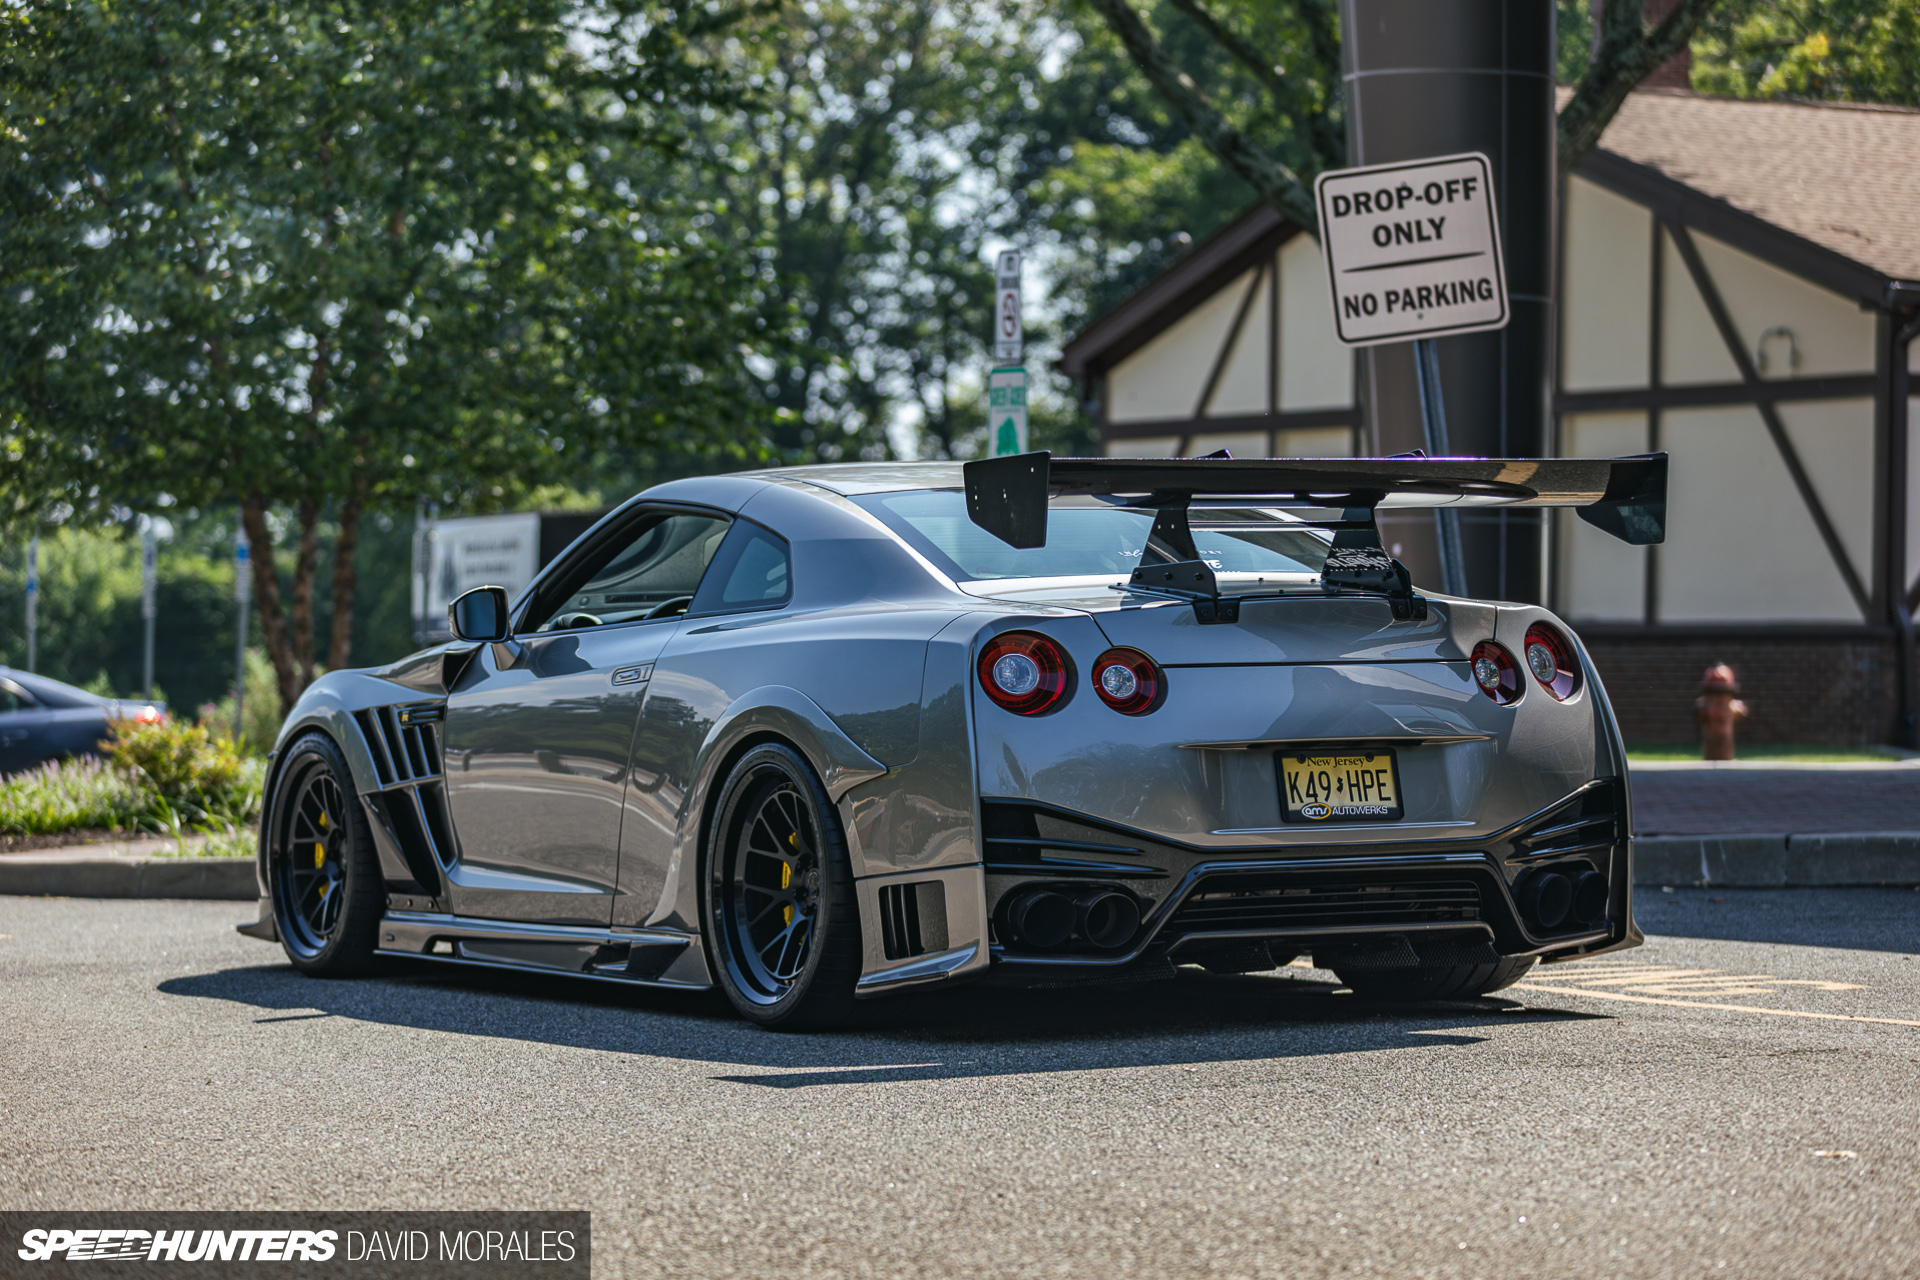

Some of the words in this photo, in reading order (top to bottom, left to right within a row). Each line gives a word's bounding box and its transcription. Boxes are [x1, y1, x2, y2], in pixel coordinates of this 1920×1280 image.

[1331, 177, 1478, 218] DROP-OFF
[1372, 216, 1446, 247] ONLY
[1343, 292, 1378, 319] NO
[1384, 277, 1493, 313] PARKING
[1307, 756, 1331, 766] New
[1333, 756, 1365, 768] Jersey
[1287, 770, 1332, 803] K49
[1346, 769, 1392, 802] HPE
[1332, 805, 1388, 815] AUTOWERKS
